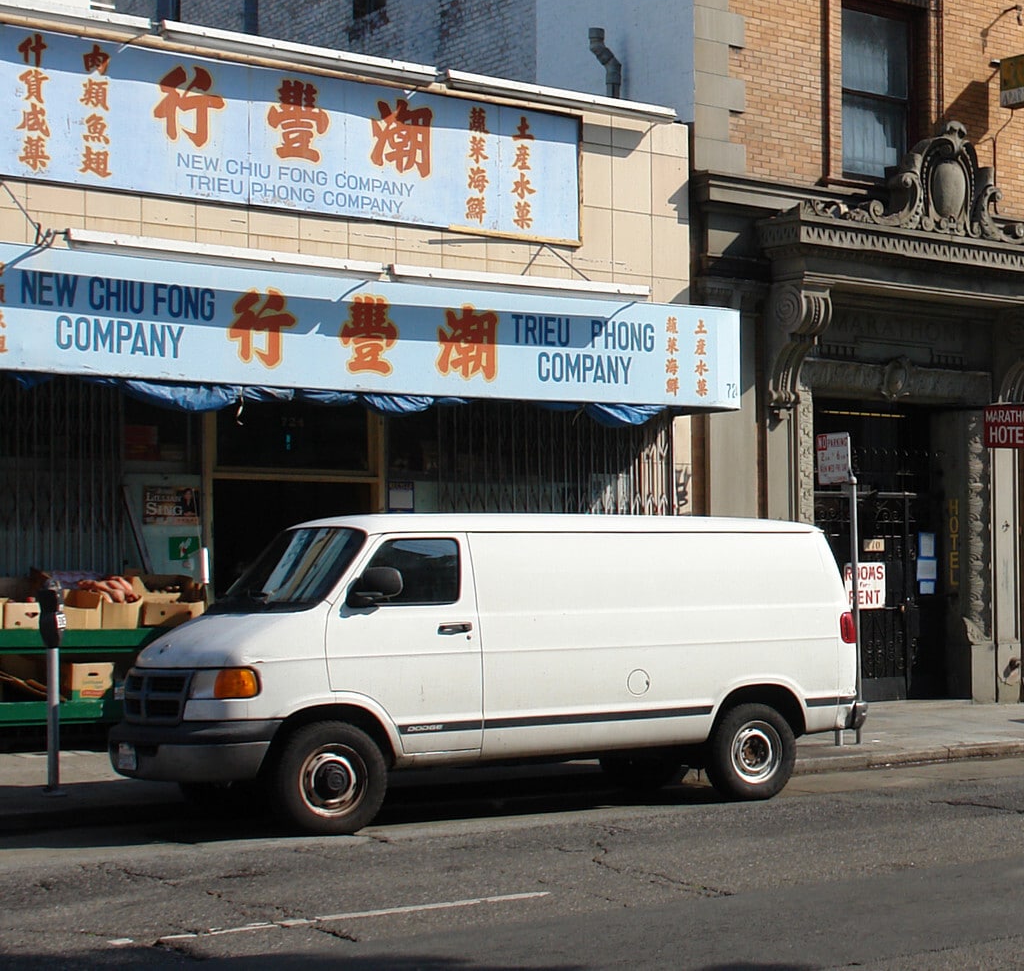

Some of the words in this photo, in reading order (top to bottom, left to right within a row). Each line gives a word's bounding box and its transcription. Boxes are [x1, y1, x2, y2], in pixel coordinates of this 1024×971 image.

[177, 152, 219, 172] NEW
[226, 159, 271, 179] CHIU
[278, 166, 328, 186] FONG
[335, 173, 415, 198] COMPANY
[186, 173, 244, 195] TRIEU
[251, 182, 316, 204] PHONG
[323, 190, 404, 214] COMPANY
[21, 269, 78, 308] NEW
[88, 276, 145, 315] CHIU
[153, 282, 216, 322] FONG
[55, 314, 185, 359] COMPANY
[511, 314, 570, 347] TRIEU
[591, 319, 655, 353] PHONG
[537, 351, 632, 385] COMPANY
[146, 502, 183, 516] SING
[948, 499, 960, 587] HOTEL
[407, 724, 445, 732] DODGE
